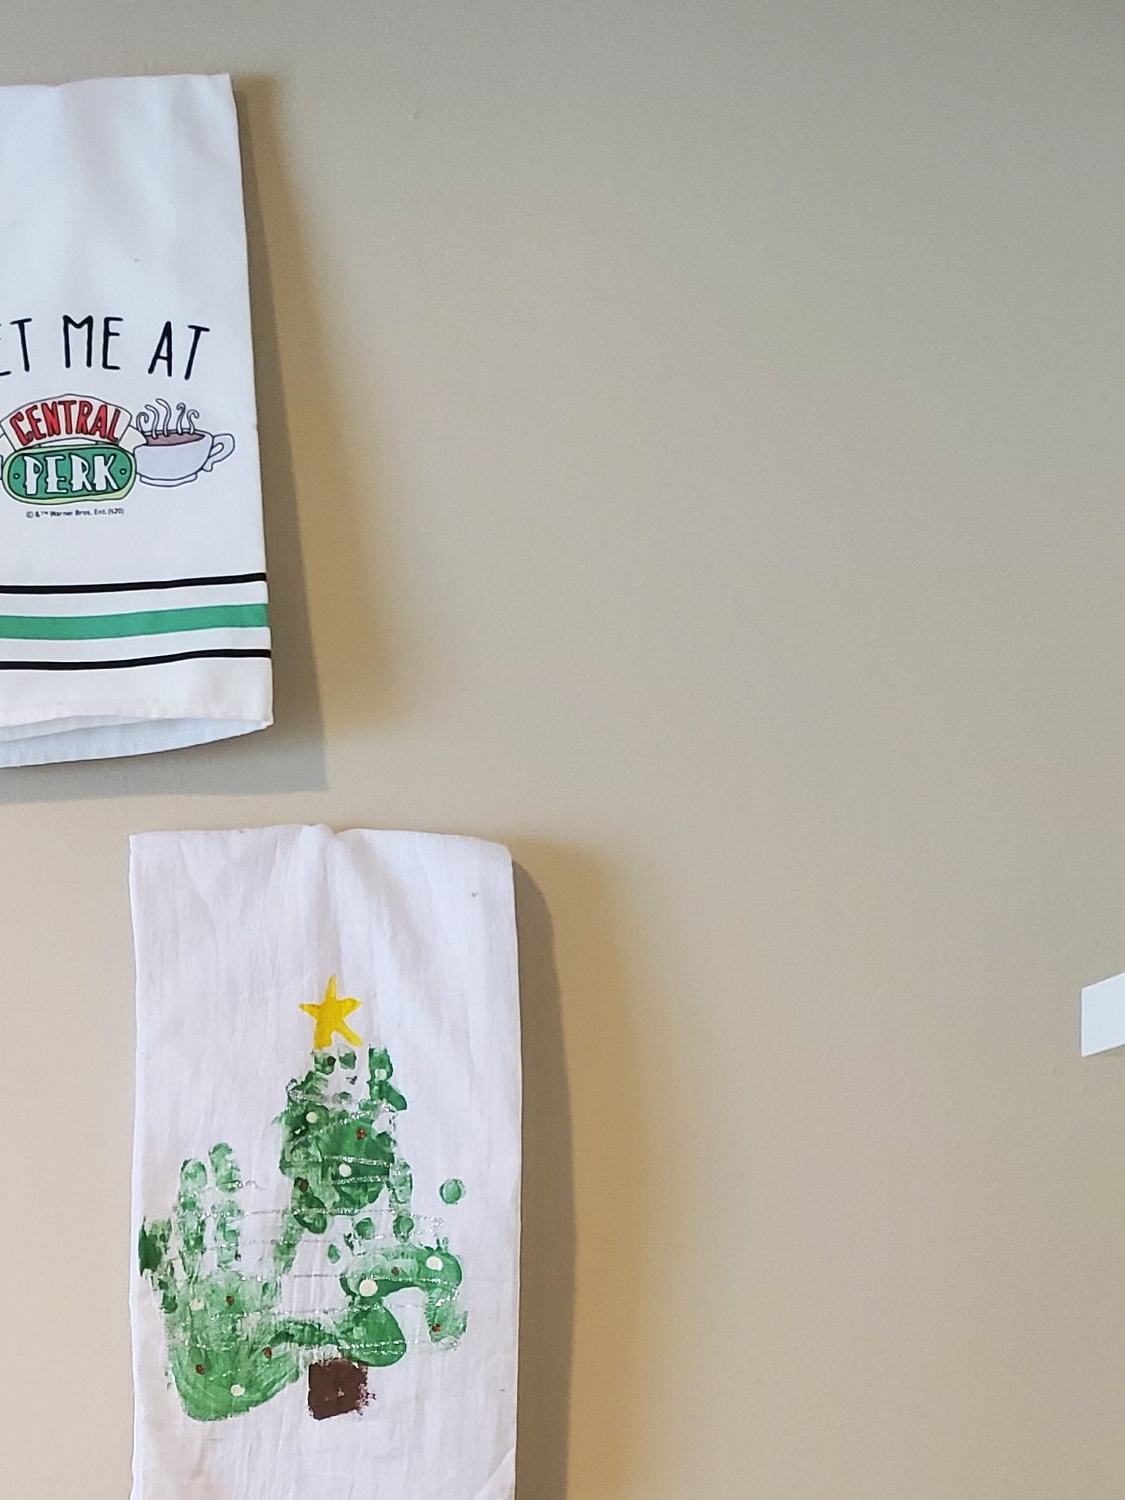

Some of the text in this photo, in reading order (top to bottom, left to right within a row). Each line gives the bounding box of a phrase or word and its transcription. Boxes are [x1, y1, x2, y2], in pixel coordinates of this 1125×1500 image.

[62, 314, 124, 371] ME
[147, 320, 211, 381] AT
[9, 399, 121, 447] CENTRAL
[22, 454, 120, 496] PERK
